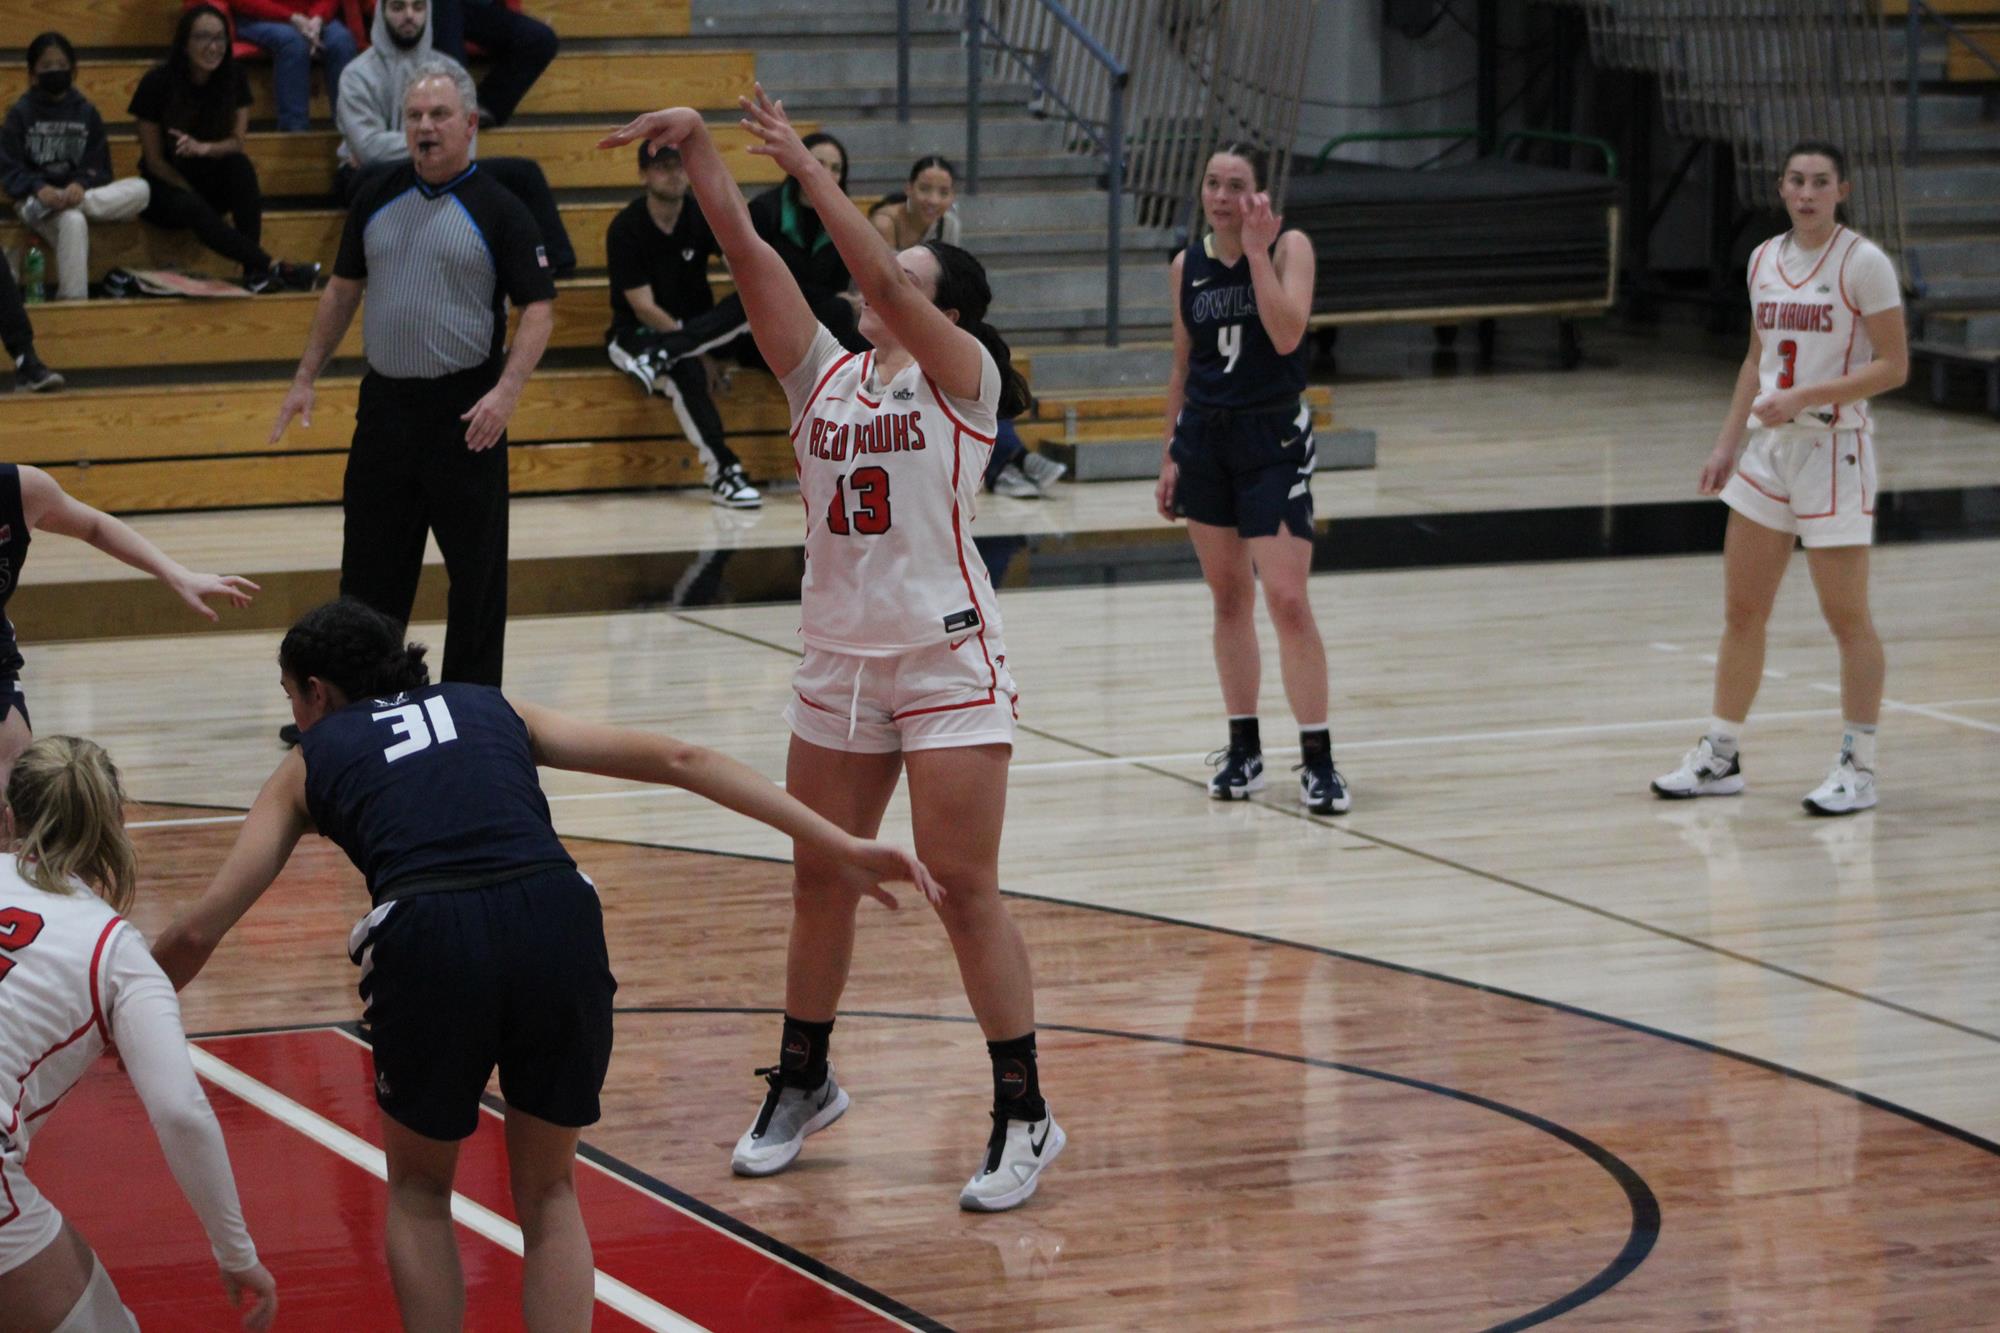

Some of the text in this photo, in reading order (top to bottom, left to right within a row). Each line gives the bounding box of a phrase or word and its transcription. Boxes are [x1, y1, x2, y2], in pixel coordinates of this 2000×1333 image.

[1757, 302, 1833, 334] RED HAWKS
[1217, 324, 1242, 373] 4
[1777, 340, 1797, 389] 3
[809, 410, 926, 463] RED HAWKS
[826, 466, 892, 535] 13
[371, 694, 458, 763] 31
